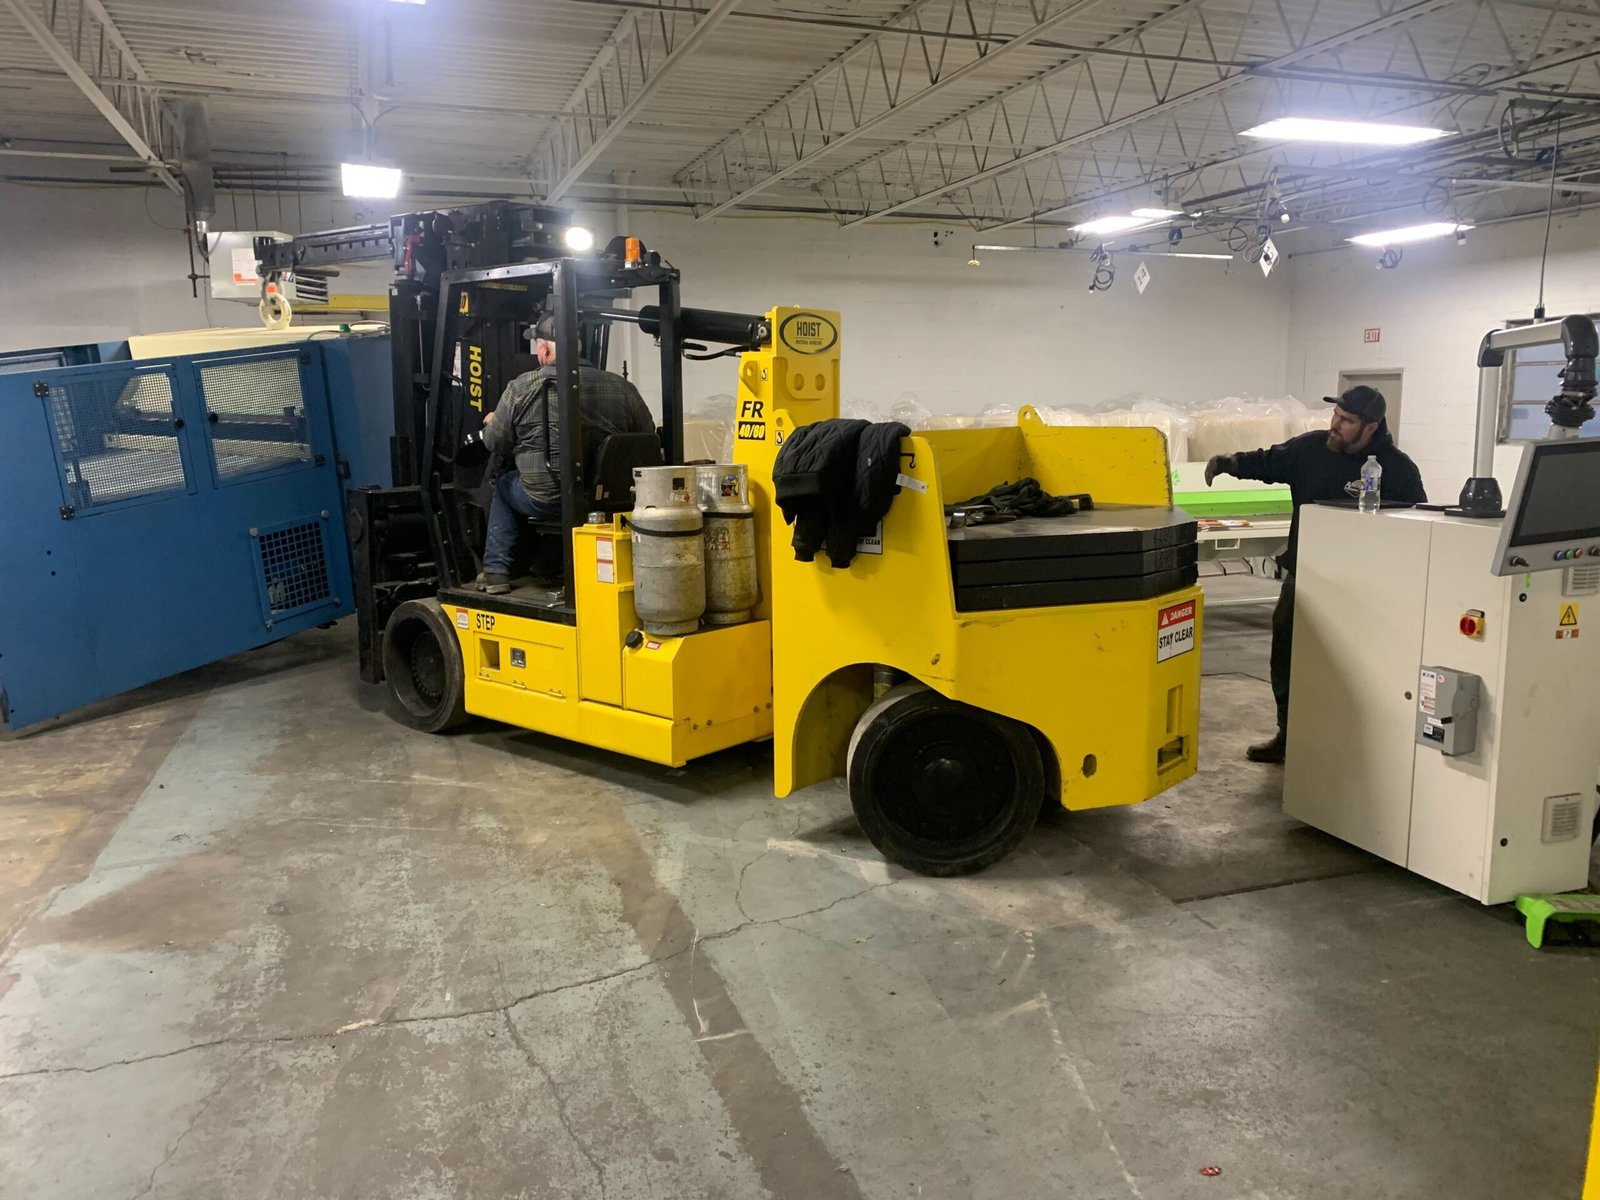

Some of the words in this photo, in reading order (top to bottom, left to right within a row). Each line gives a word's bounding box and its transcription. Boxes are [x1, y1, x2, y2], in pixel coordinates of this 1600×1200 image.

[796, 321, 821, 337] HOIST
[469, 345, 482, 412] HOIST
[741, 400, 764, 418] FR
[739, 424, 765, 439] 40/60
[476, 613, 495, 631] STEP
[1170, 606, 1193, 621] DANGER
[1159, 632, 1174, 649] STAY
[1174, 626, 1193, 643] CLEAR
